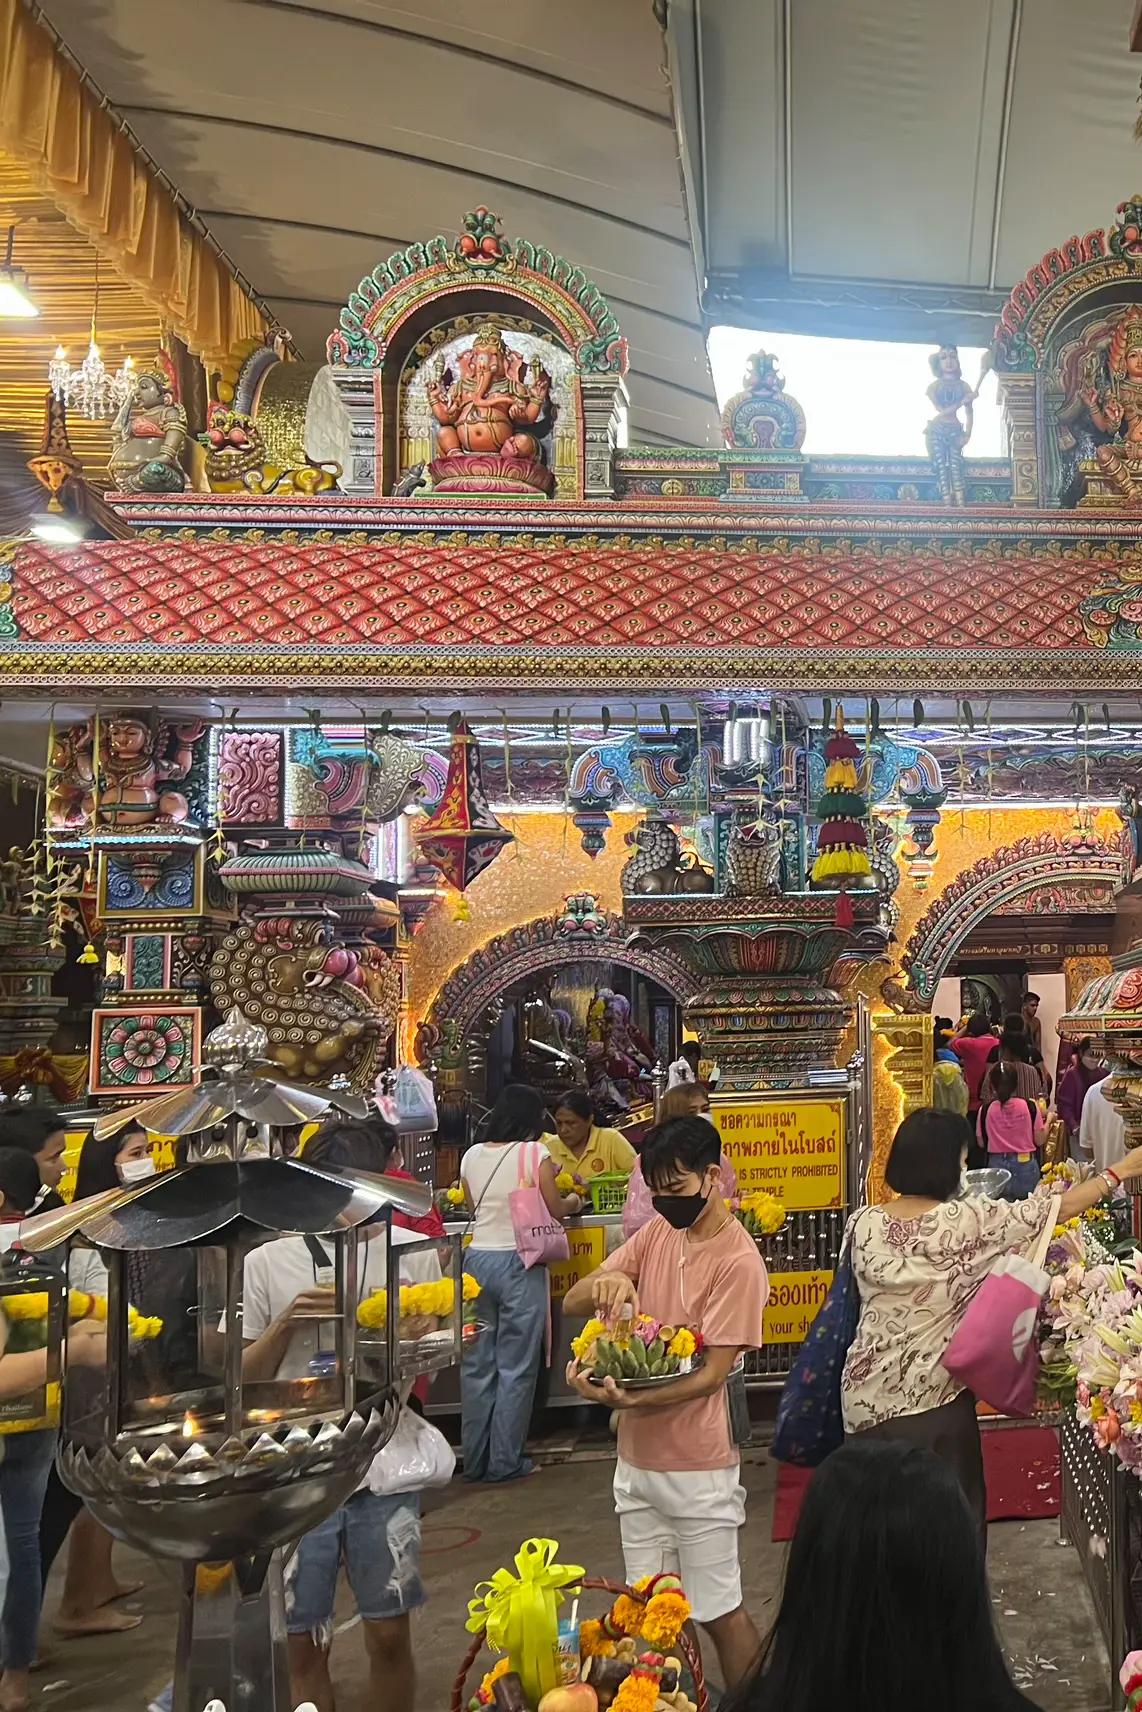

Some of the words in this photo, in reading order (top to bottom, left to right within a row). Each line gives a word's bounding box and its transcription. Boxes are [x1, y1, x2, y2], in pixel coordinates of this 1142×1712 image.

[720, 1112, 796, 1135] ขอความกรุณา
[723, 1130, 836, 1157] ภาพภายในโบสถ์
[739, 1170, 747, 1180] IS
[750, 1167, 788, 1180] STRICTLY
[792, 1164, 838, 1178] PROHIBITED
[573, 1242, 592, 1256] บาท
[764, 1276, 827, 1307] รองเท้า
[770, 1321, 793, 1338] your
